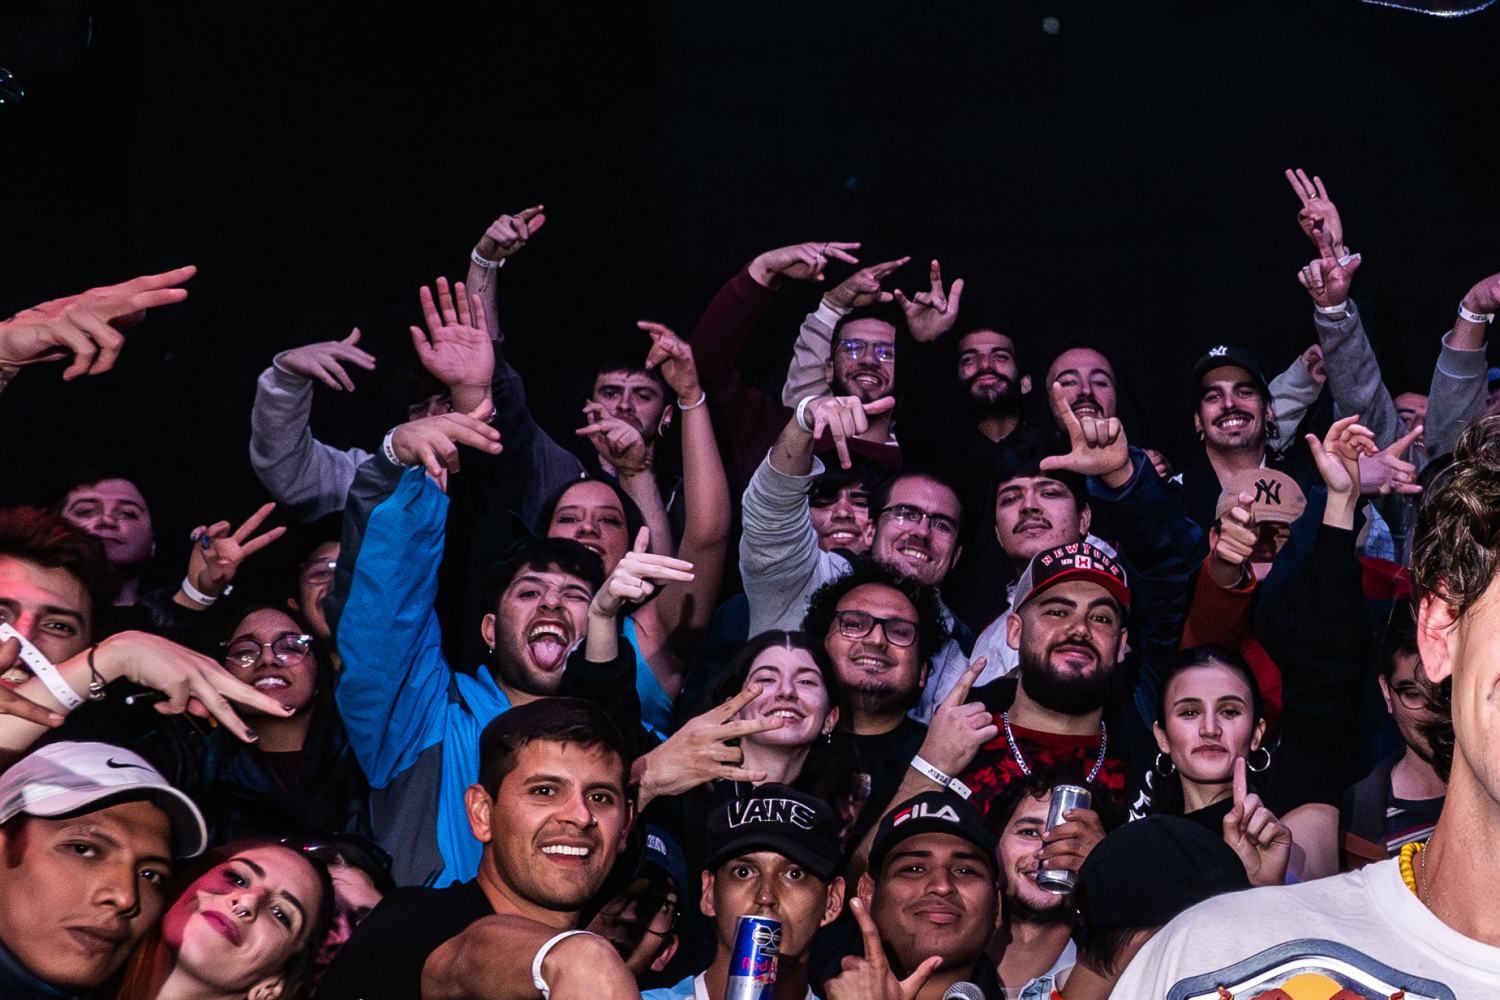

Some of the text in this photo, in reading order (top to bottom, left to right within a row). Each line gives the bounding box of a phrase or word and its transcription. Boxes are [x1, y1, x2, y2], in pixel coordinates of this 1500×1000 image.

[1254, 478, 1282, 505] NY
[1041, 542, 1079, 566] NEW
[727, 799, 816, 830] VANS
